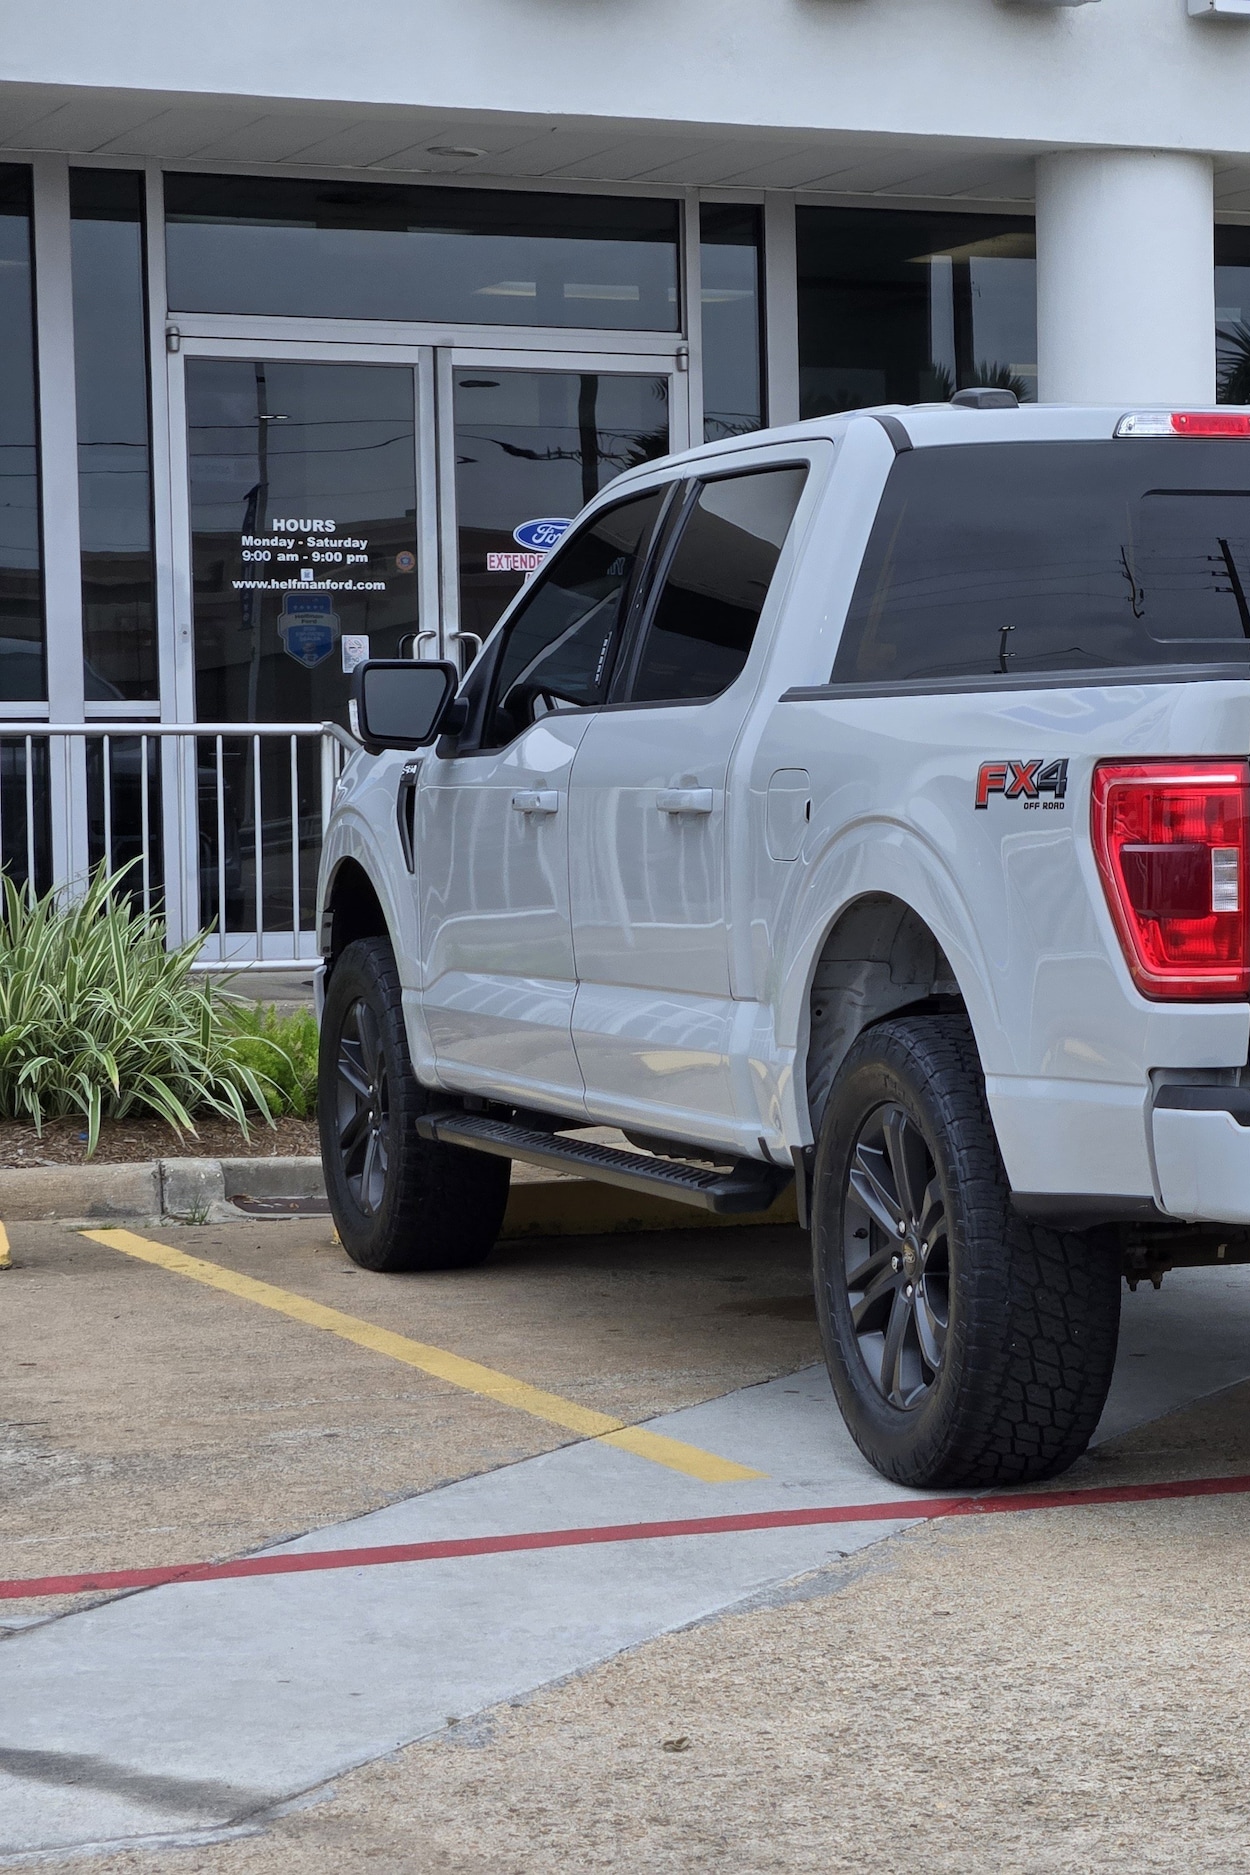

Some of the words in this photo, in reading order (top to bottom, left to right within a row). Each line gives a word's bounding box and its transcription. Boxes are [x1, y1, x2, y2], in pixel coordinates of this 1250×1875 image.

[272, 518, 337, 533] HOURS
[241, 535, 295, 549] Monday
[307, 537, 368, 550] Saturday
[242, 550, 272, 562] 9:00
[276, 552, 299, 562] am
[311, 551, 343, 563] 9:00
[346, 554, 369, 565] pm
[232, 579, 386, 591] www.helfmanford.com
[975, 758, 1070, 810] FX4
[1023, 802, 1040, 810] OFF
[1042, 802, 1065, 810] ROAD
